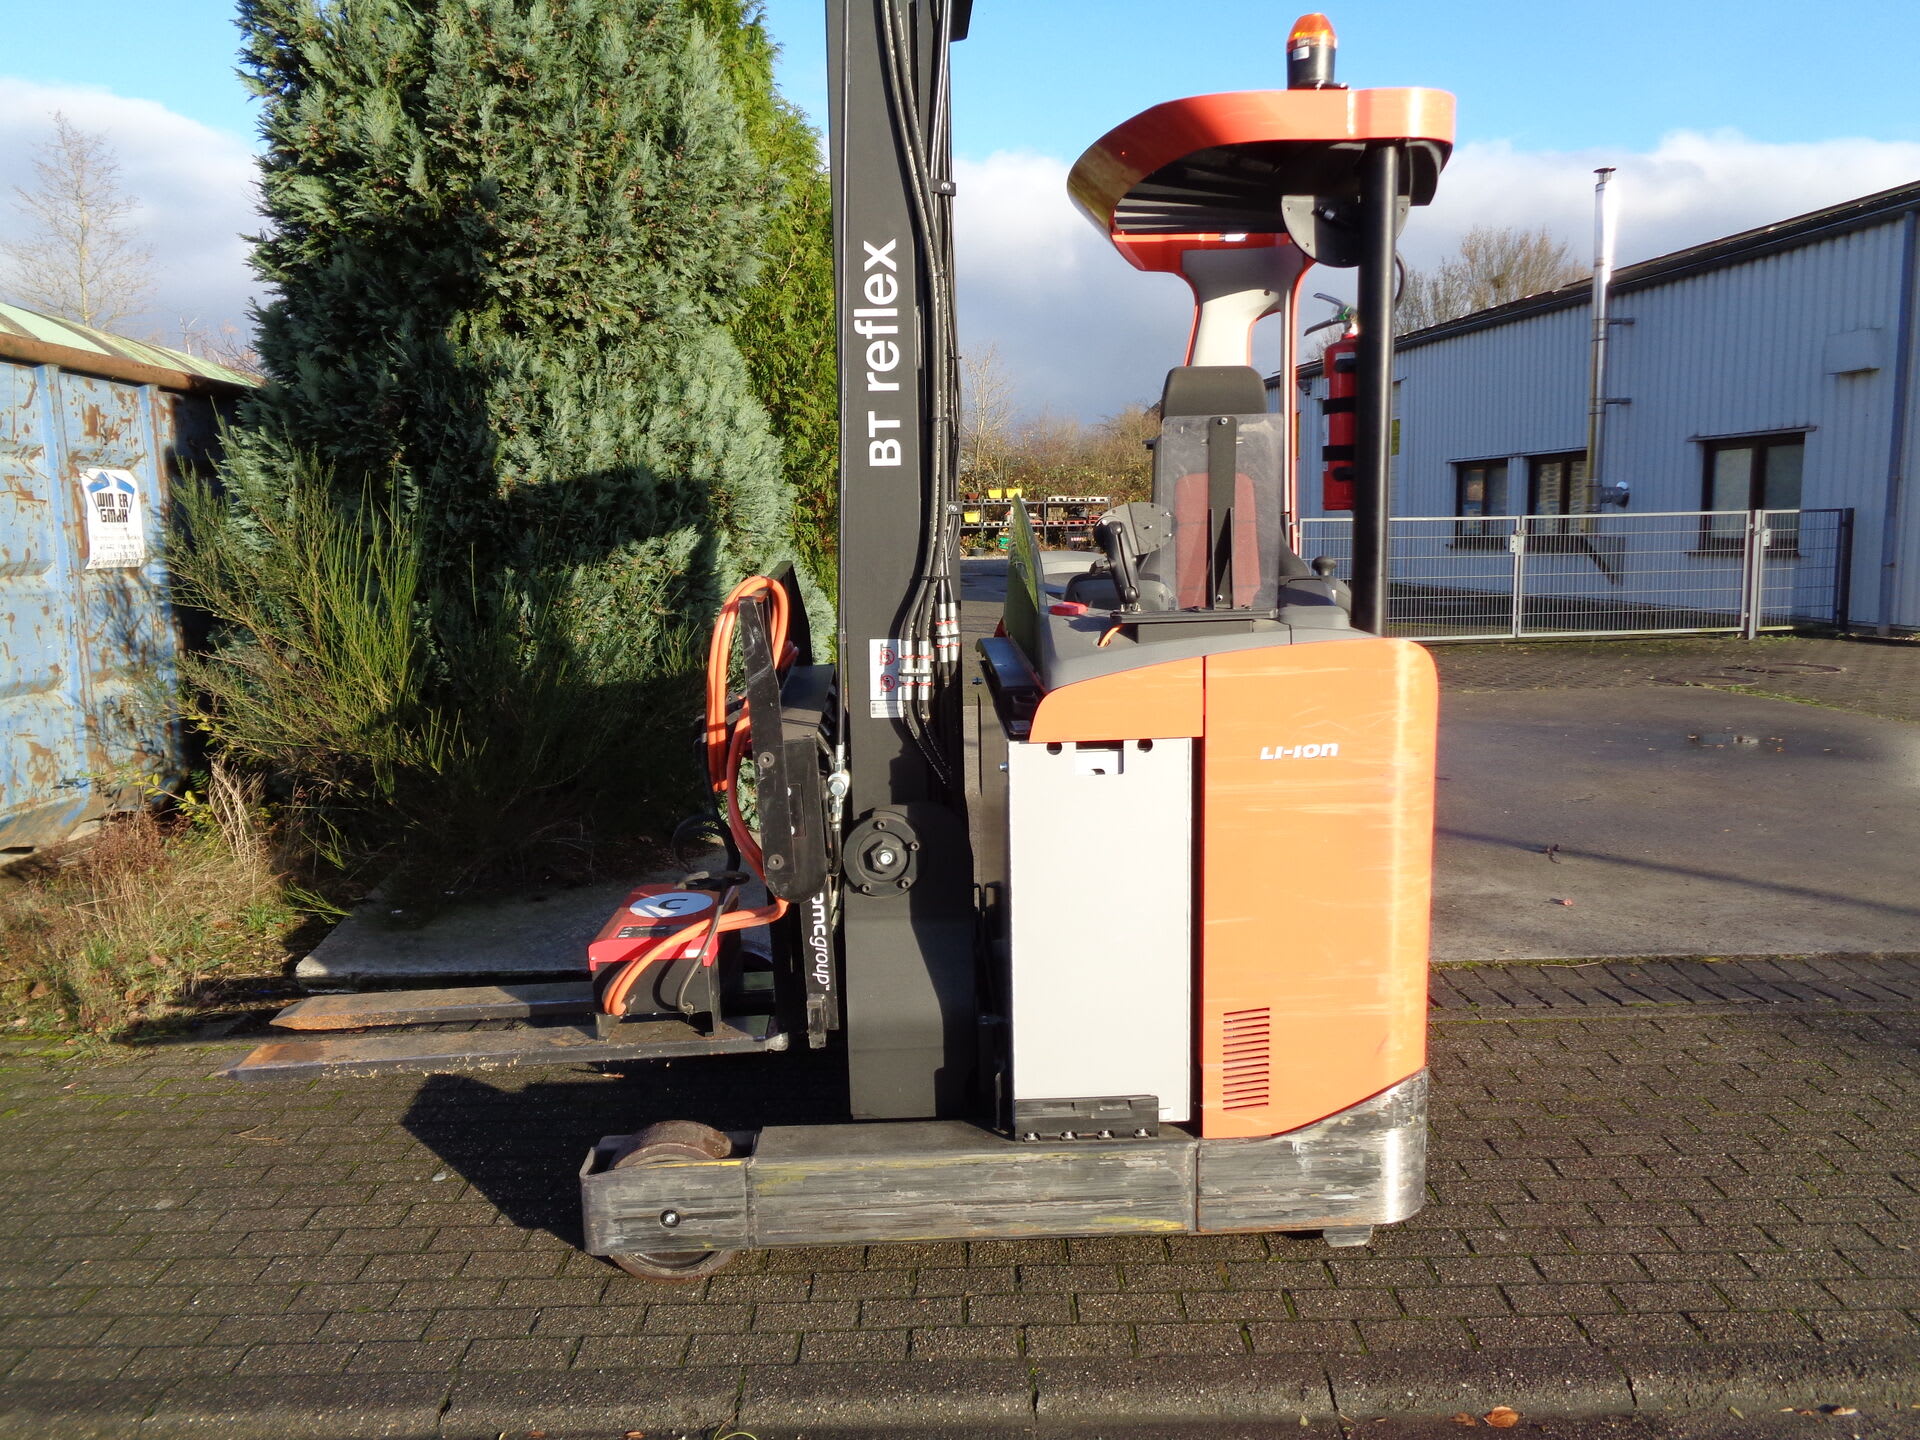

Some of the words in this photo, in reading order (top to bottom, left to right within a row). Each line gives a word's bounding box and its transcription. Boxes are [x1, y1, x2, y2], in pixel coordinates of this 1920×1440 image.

[853, 238, 900, 392] reflex
[868, 411, 901, 467] BT
[96, 492, 129, 508] WINER
